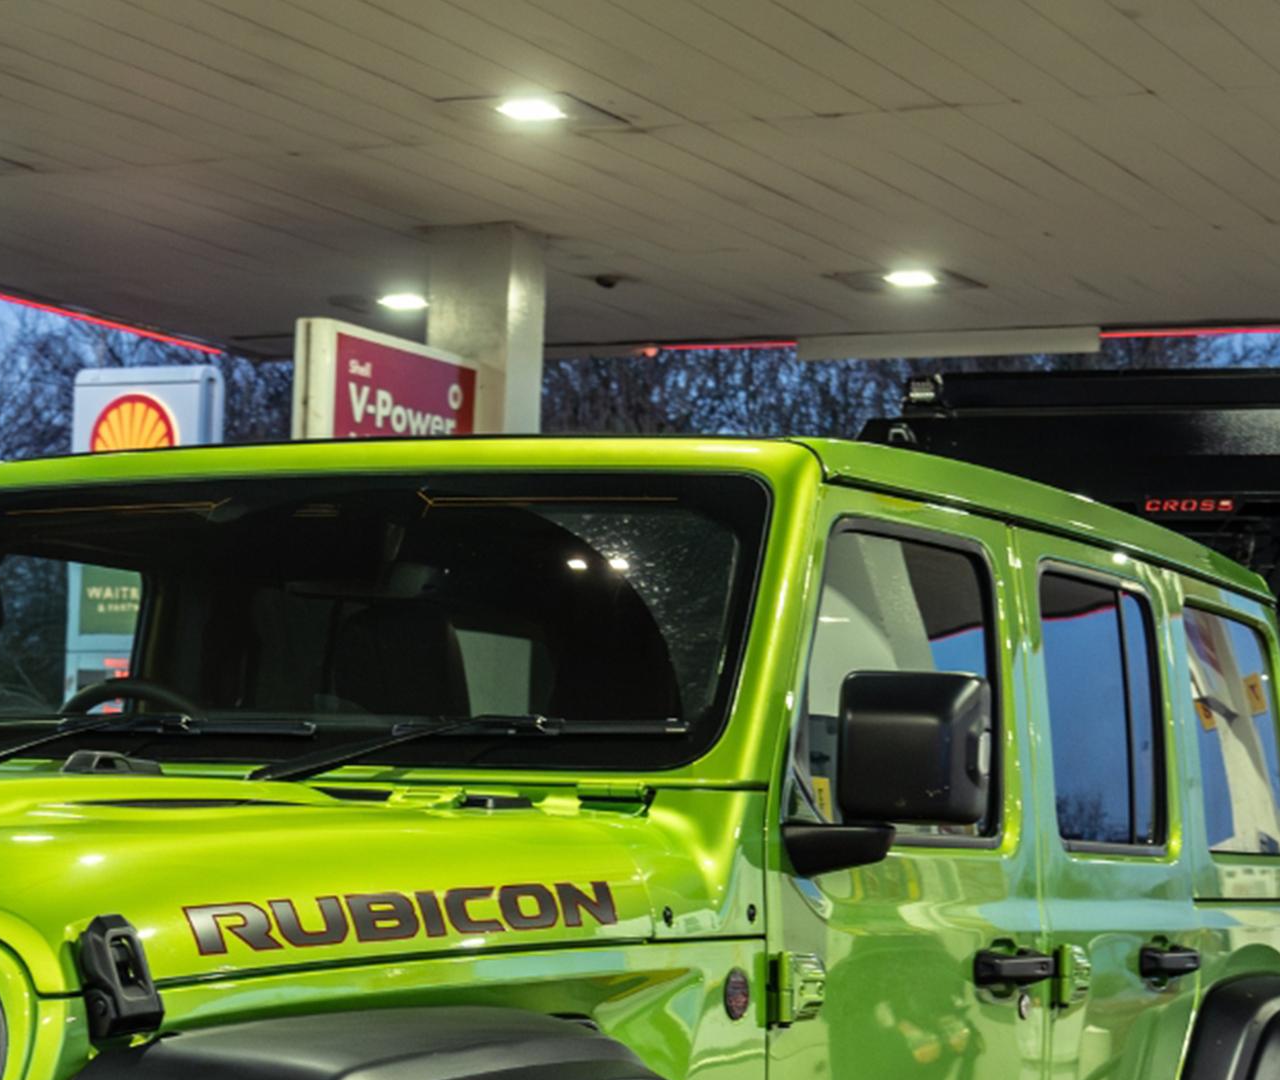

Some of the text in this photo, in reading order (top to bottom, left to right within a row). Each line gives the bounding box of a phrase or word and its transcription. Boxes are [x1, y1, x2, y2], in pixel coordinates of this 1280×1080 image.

[348, 358, 373, 378] Shell
[348, 381, 457, 436] V-Power
[1145, 499, 1234, 512] CROSS
[182, 881, 618, 956] RUBICON
